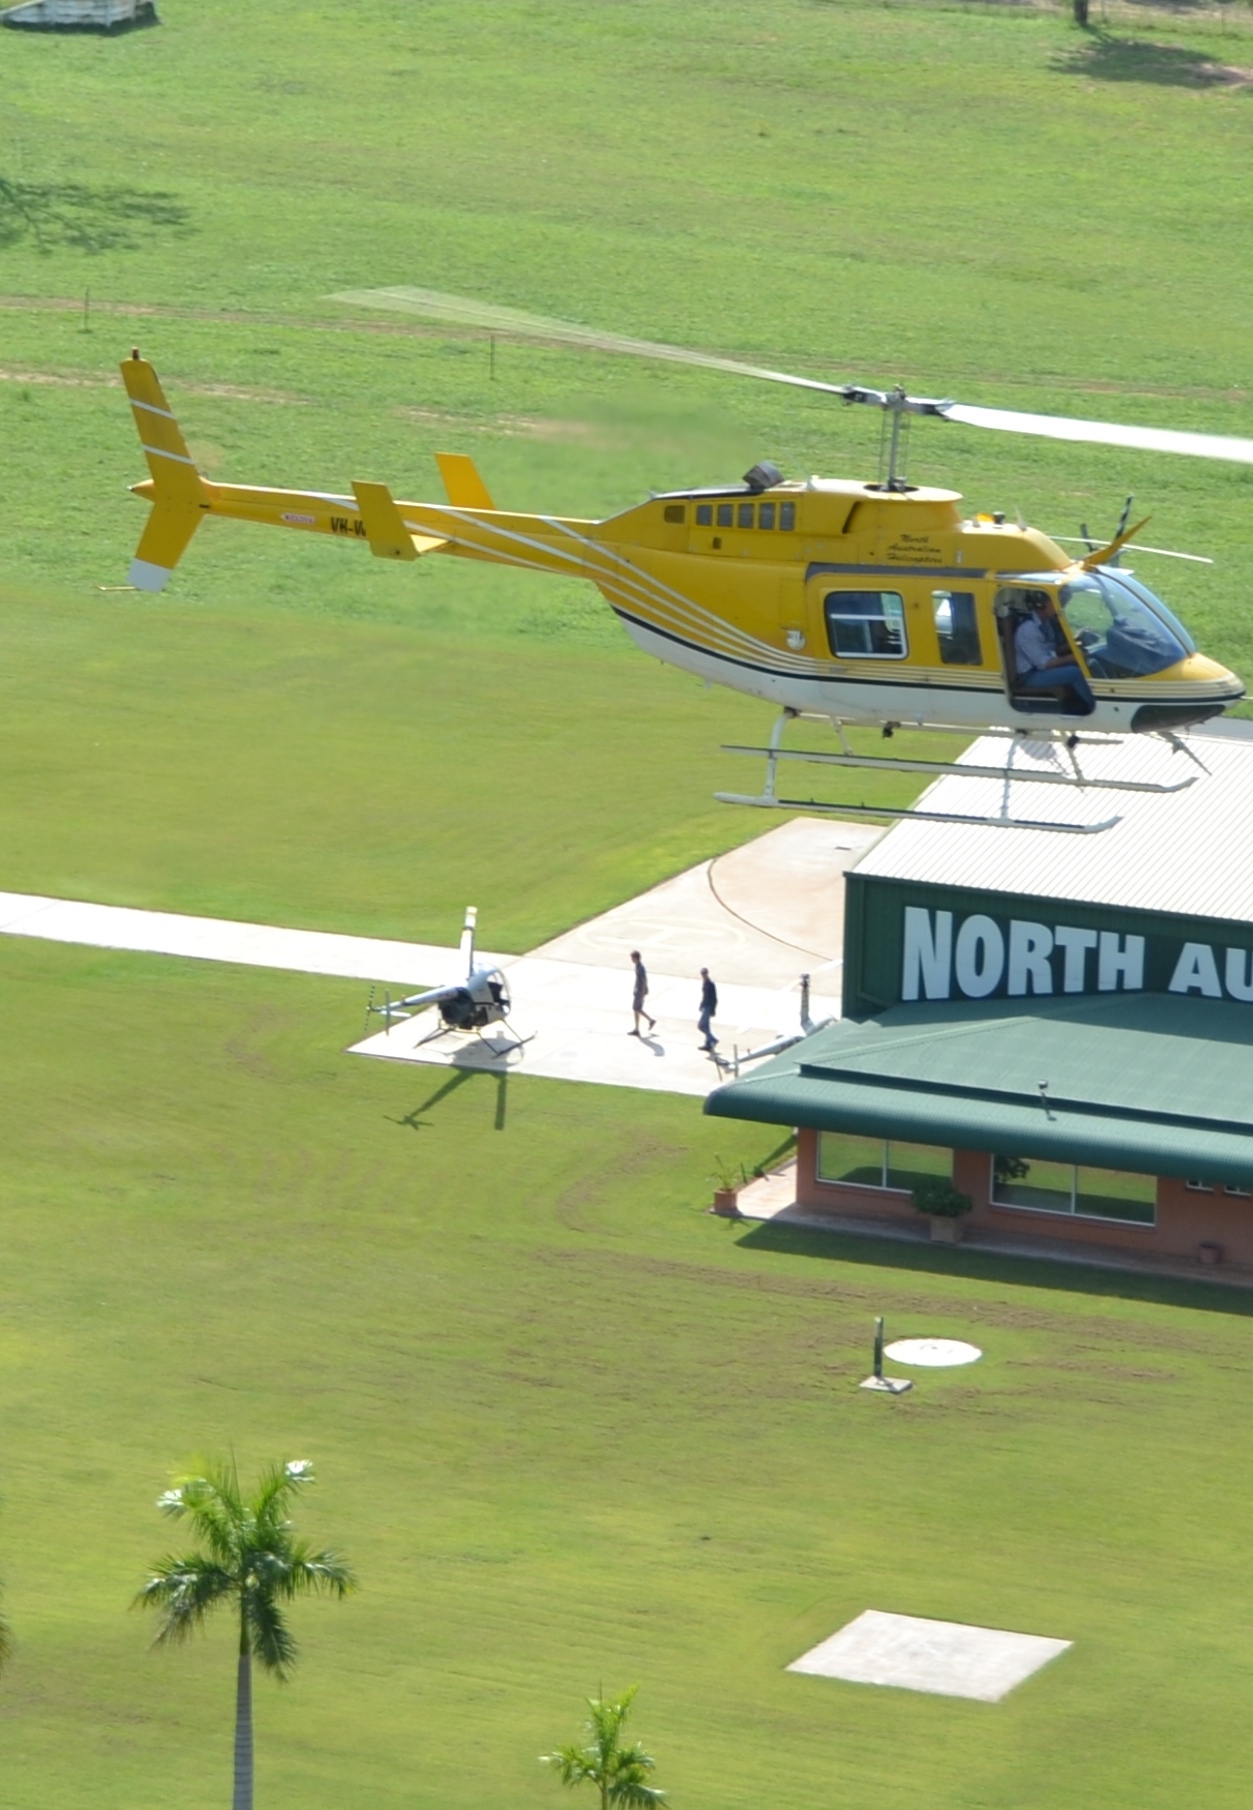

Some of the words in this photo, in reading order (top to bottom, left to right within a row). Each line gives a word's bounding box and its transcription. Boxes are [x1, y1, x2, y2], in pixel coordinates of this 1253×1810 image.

[900, 534, 929, 543] North
[888, 543, 941, 553] Australian
[886, 553, 942, 563] Helicopters
[902, 905, 1145, 1001] NORTH
